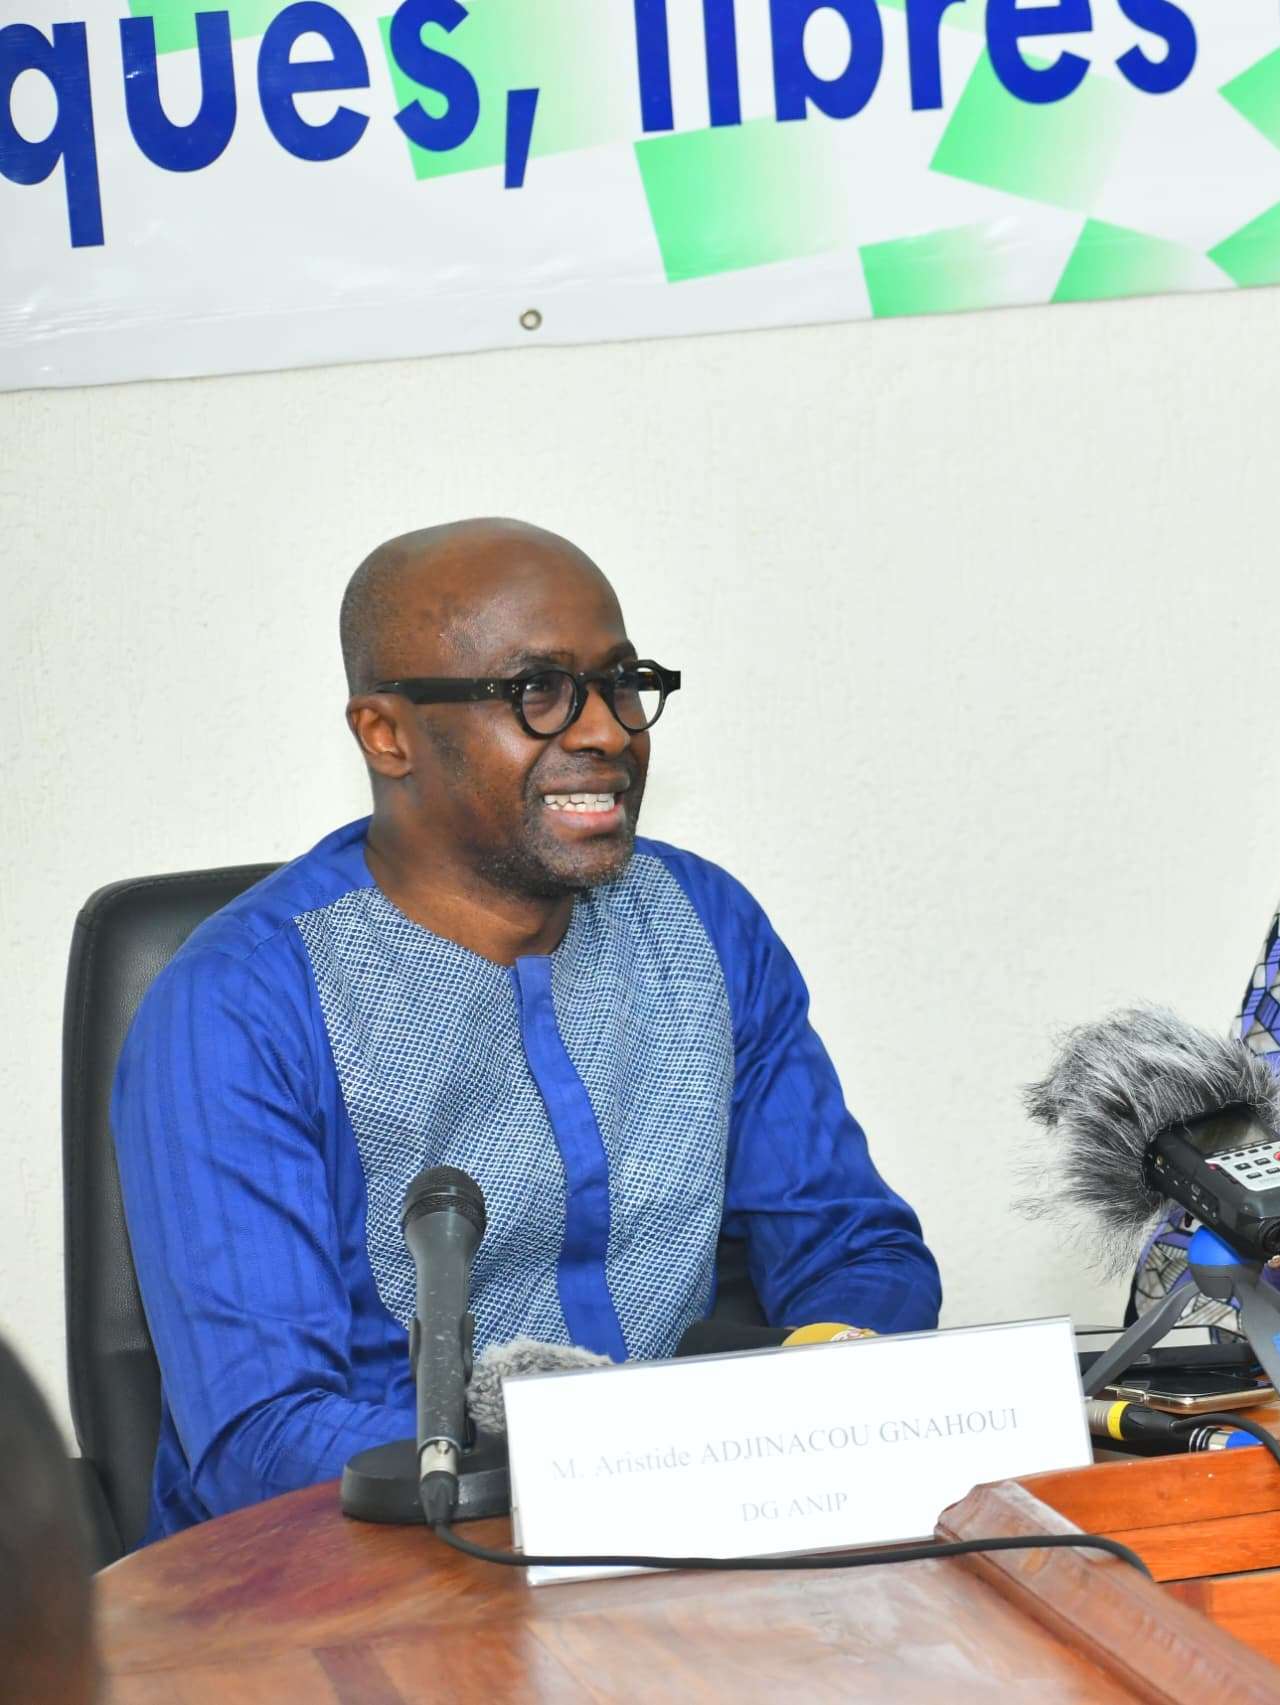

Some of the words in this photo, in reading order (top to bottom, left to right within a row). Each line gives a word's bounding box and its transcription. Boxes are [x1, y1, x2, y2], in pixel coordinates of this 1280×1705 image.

[551, 1457, 584, 1480] M.
[594, 1446, 691, 1477] Aristide
[701, 1424, 870, 1465] ADJINACOU
[879, 1407, 1018, 1443] GNAHOUI
[741, 1500, 780, 1522] DG
[787, 1491, 848, 1518] ANIP
